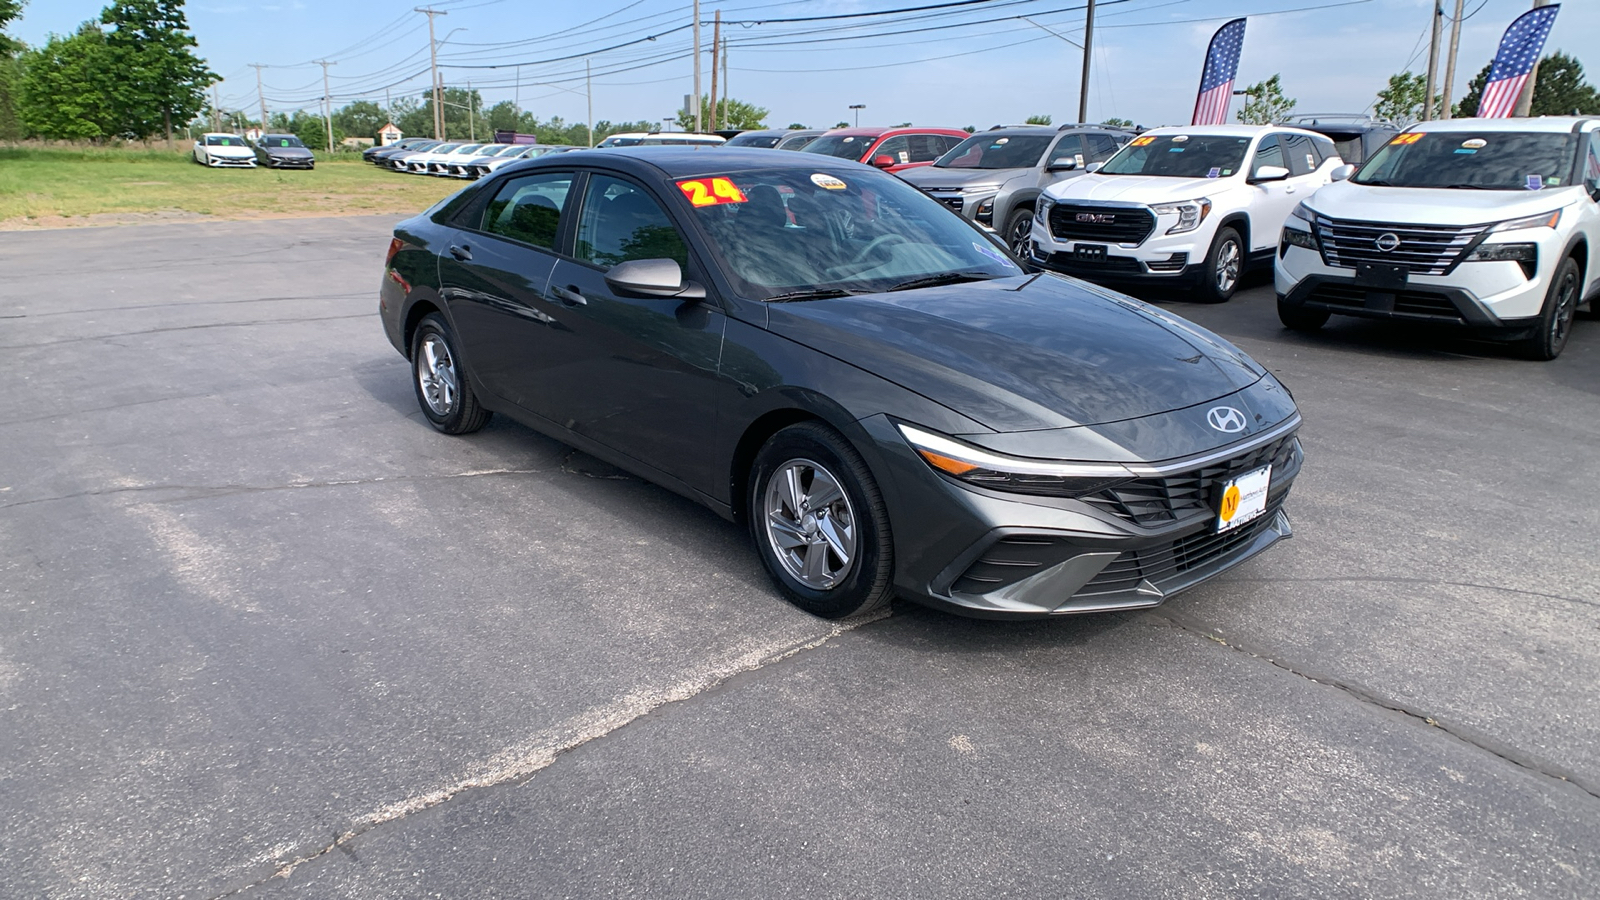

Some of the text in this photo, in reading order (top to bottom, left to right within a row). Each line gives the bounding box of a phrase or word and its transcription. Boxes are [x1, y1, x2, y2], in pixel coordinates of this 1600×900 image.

[681, 178, 742, 205] 24
[1075, 213, 1115, 223] GMC
[1223, 493, 1237, 514] M
